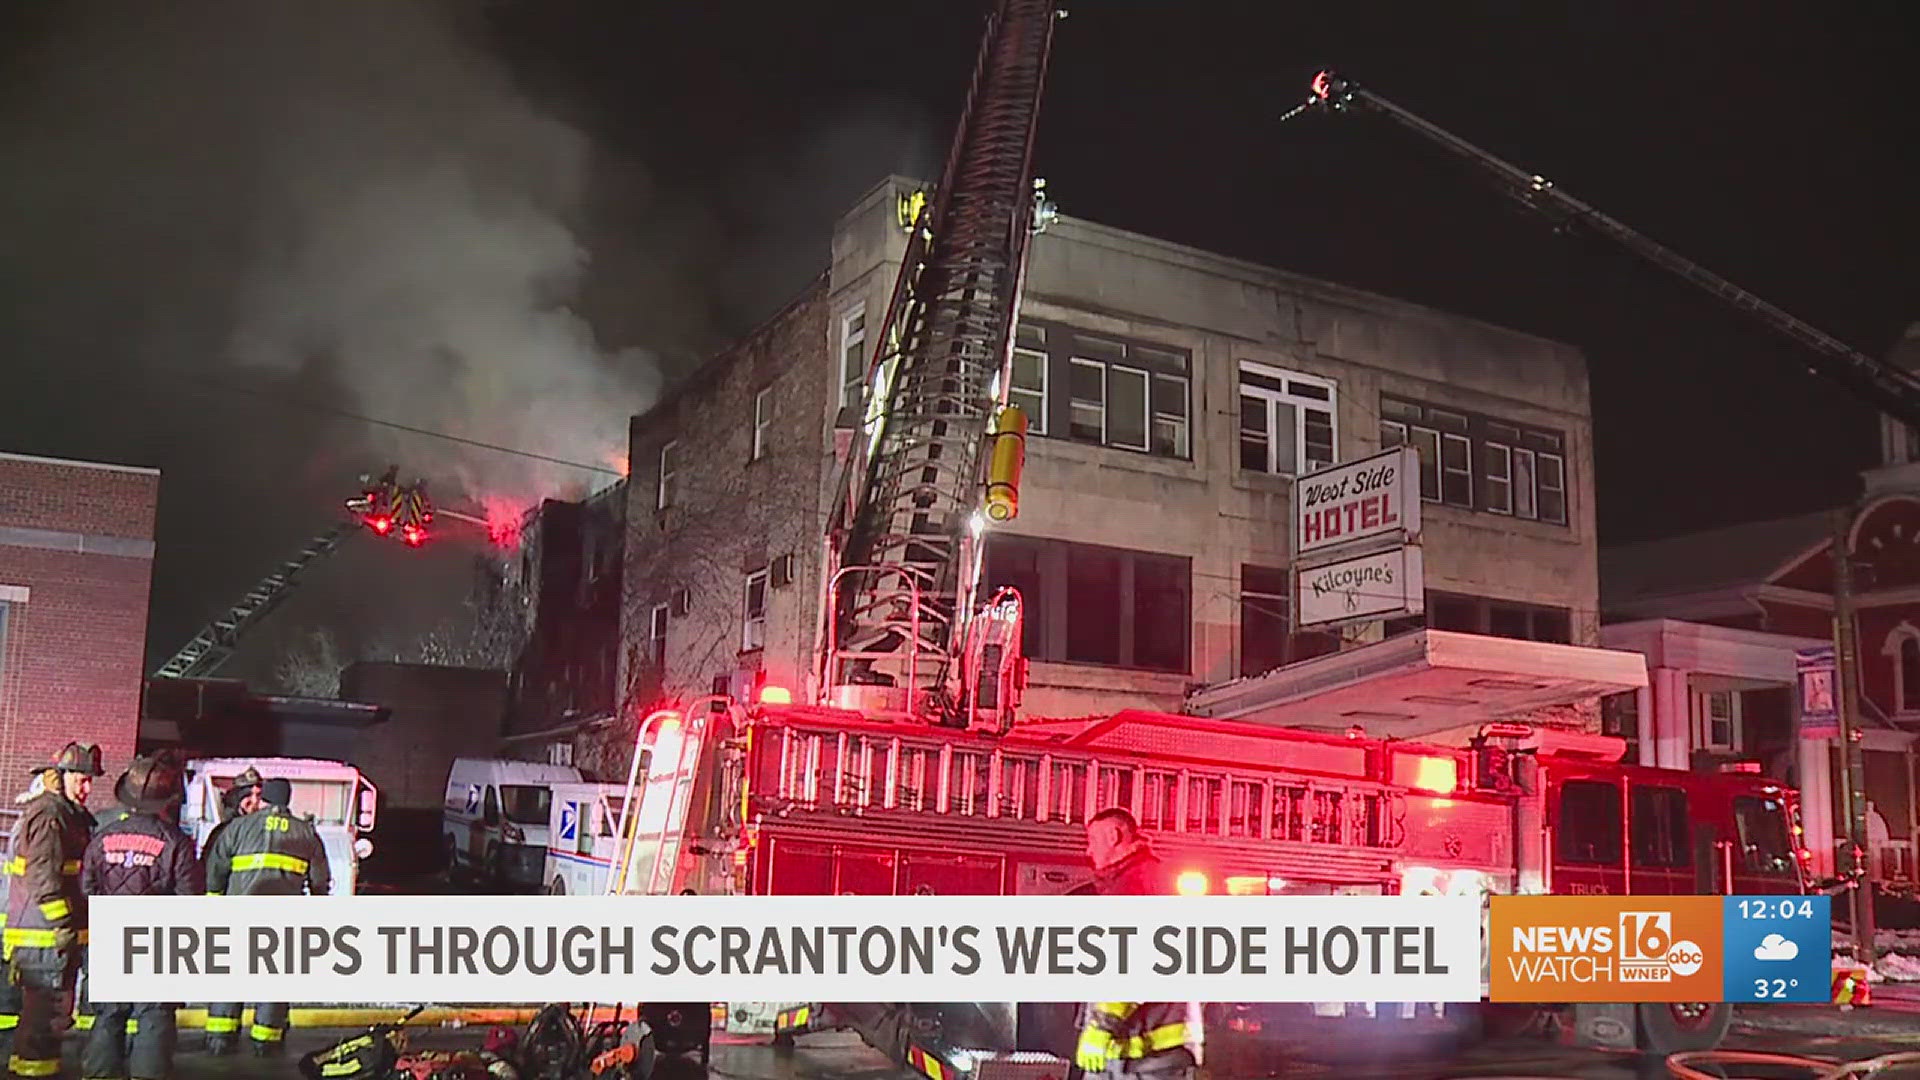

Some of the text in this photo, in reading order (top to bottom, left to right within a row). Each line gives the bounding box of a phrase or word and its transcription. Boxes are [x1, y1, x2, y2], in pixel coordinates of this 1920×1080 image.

[1305, 465, 1395, 507] West Side
[1304, 494, 1397, 544] HOTEL
[1312, 563, 1395, 598] Kilcoyne's
[1570, 882, 1609, 895] TRUCK
